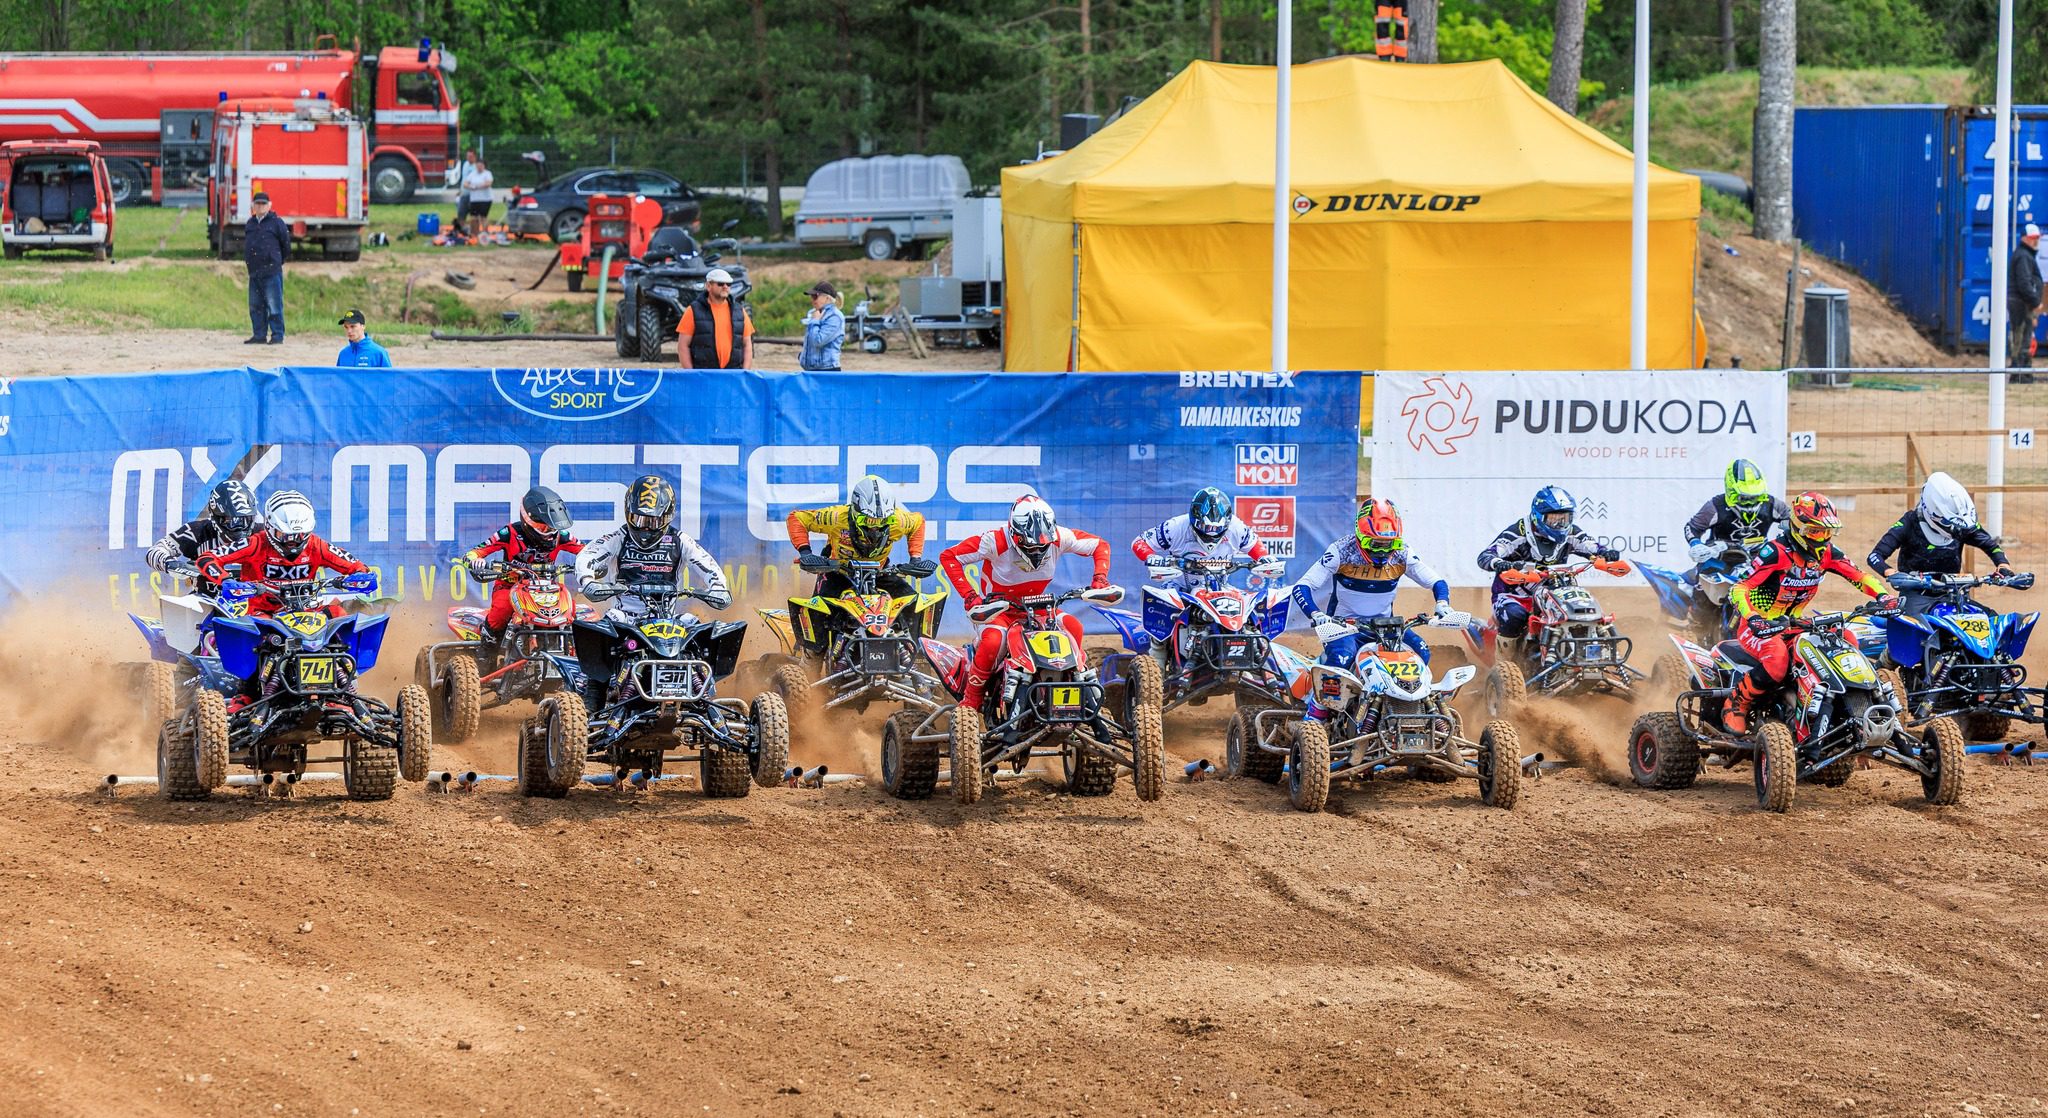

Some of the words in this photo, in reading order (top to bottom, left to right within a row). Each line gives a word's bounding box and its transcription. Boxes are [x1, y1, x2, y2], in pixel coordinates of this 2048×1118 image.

[1323, 194, 1481, 212] DUNLOP
[1178, 371, 1295, 388] BRENTEX
[550, 392, 606, 409] SPORT
[1180, 407, 1302, 427] YAMAHAKESKUS
[1494, 399, 1758, 434] PUIDUKODA
[1793, 434, 1813, 450] 12
[2011, 430, 2032, 445] 14
[1239, 446, 1297, 465] LIQUI
[1563, 447, 1612, 459] WOOD
[1619, 447, 1649, 459] FOR
[1655, 447, 1688, 459] LIFE
[1238, 466, 1297, 484] MOLY
[1597, 535, 1668, 553] ROUPE
[622, 549, 673, 561] ALCANTRA
[265, 563, 311, 579] FXR
[1215, 599, 1241, 612] 22
[864, 613, 887, 626] 39
[1960, 620, 1989, 634] 286
[1043, 633, 1060, 655] 1
[1227, 645, 1246, 657] 22
[302, 660, 333, 682] 741
[658, 671, 686, 684] 311
[1388, 663, 1421, 678] 222
[1061, 690, 1071, 704] 1
